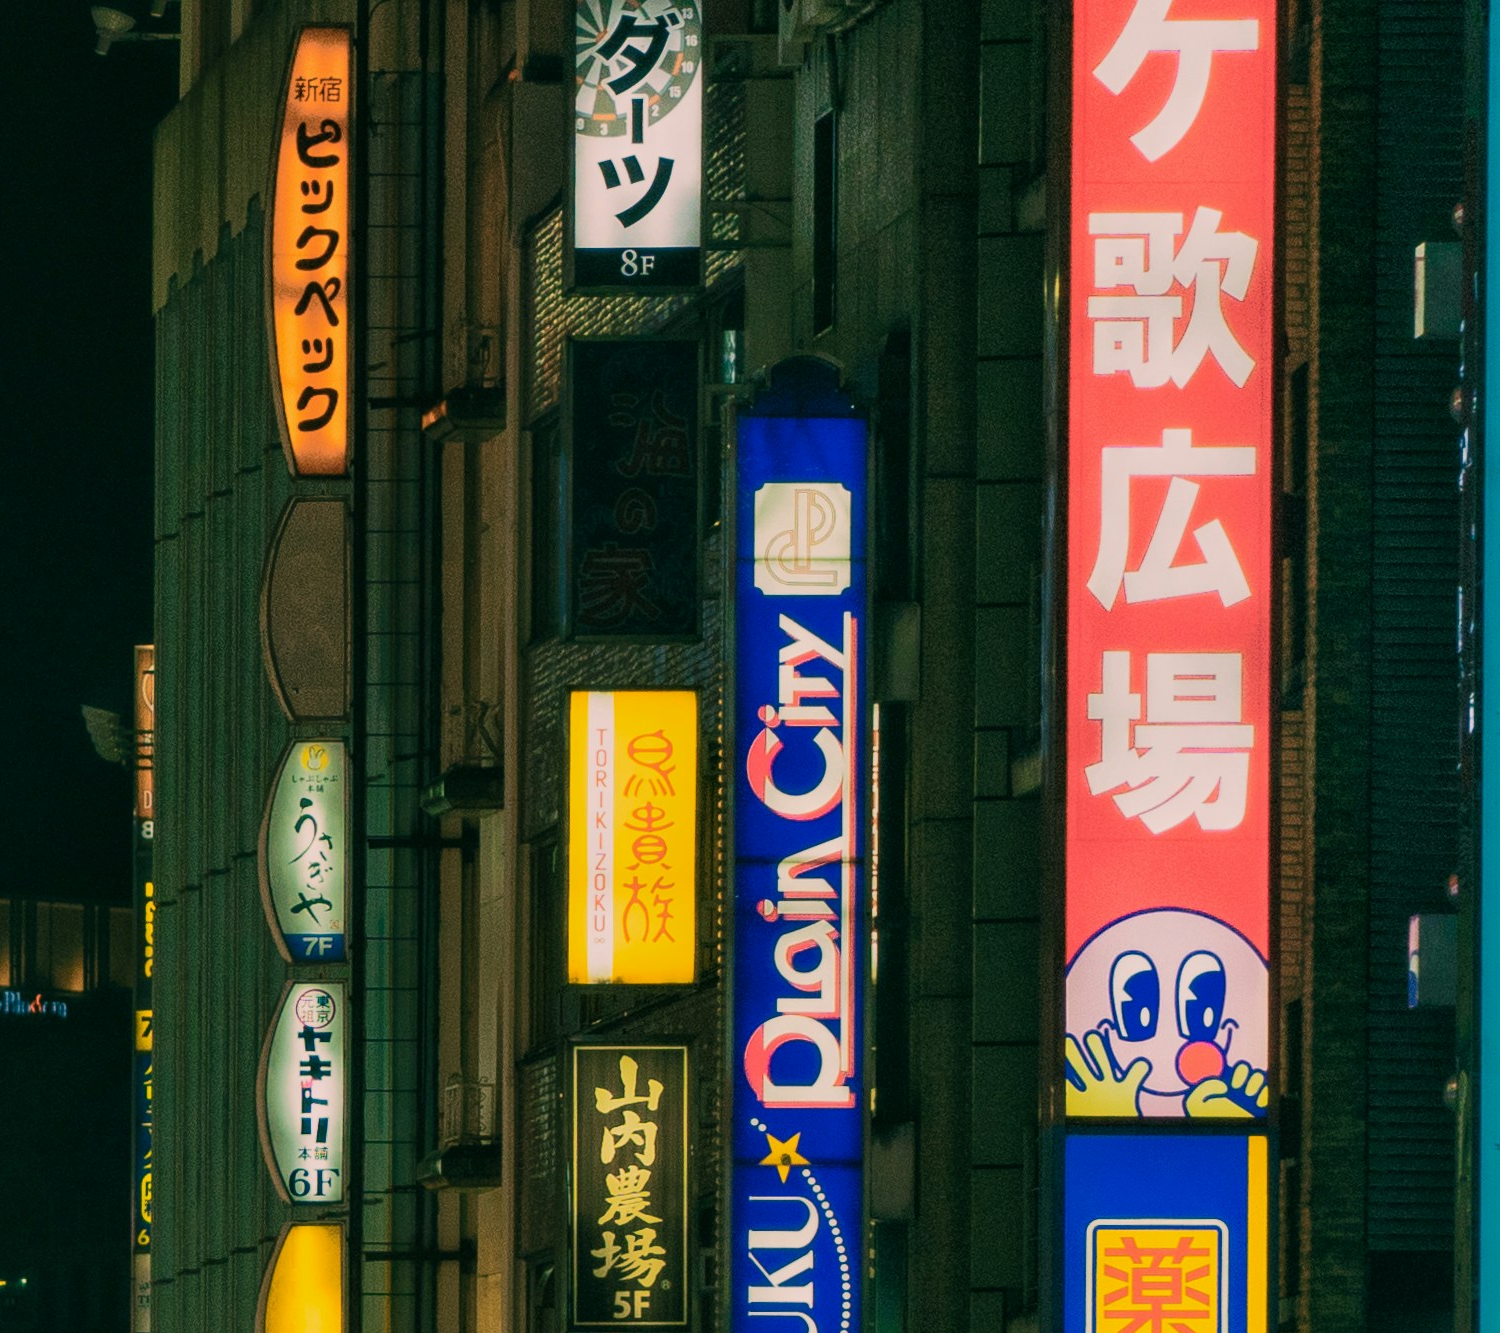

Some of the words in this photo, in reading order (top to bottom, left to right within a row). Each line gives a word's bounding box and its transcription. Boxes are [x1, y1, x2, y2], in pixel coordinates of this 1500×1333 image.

[293, 75, 342, 103] 新宿
[596, 11, 684, 229] ダーツ
[620, 250, 656, 277] 8F
[1084, 0, 1260, 836] ケ歌広場
[288, 797, 335, 928] うさぎや
[594, 728, 608, 934] TORIKIZOKU
[621, 729, 677, 945] 鳥貴族
[301, 936, 334, 957] 7F
[297, 1025, 333, 1144] ヤキトリ
[287, 1166, 341, 1199] 6F
[297, 1146, 330, 1162] 本舗
[590, 1054, 668, 1288] 山内農場
[613, 1290, 651, 1319] 5F
